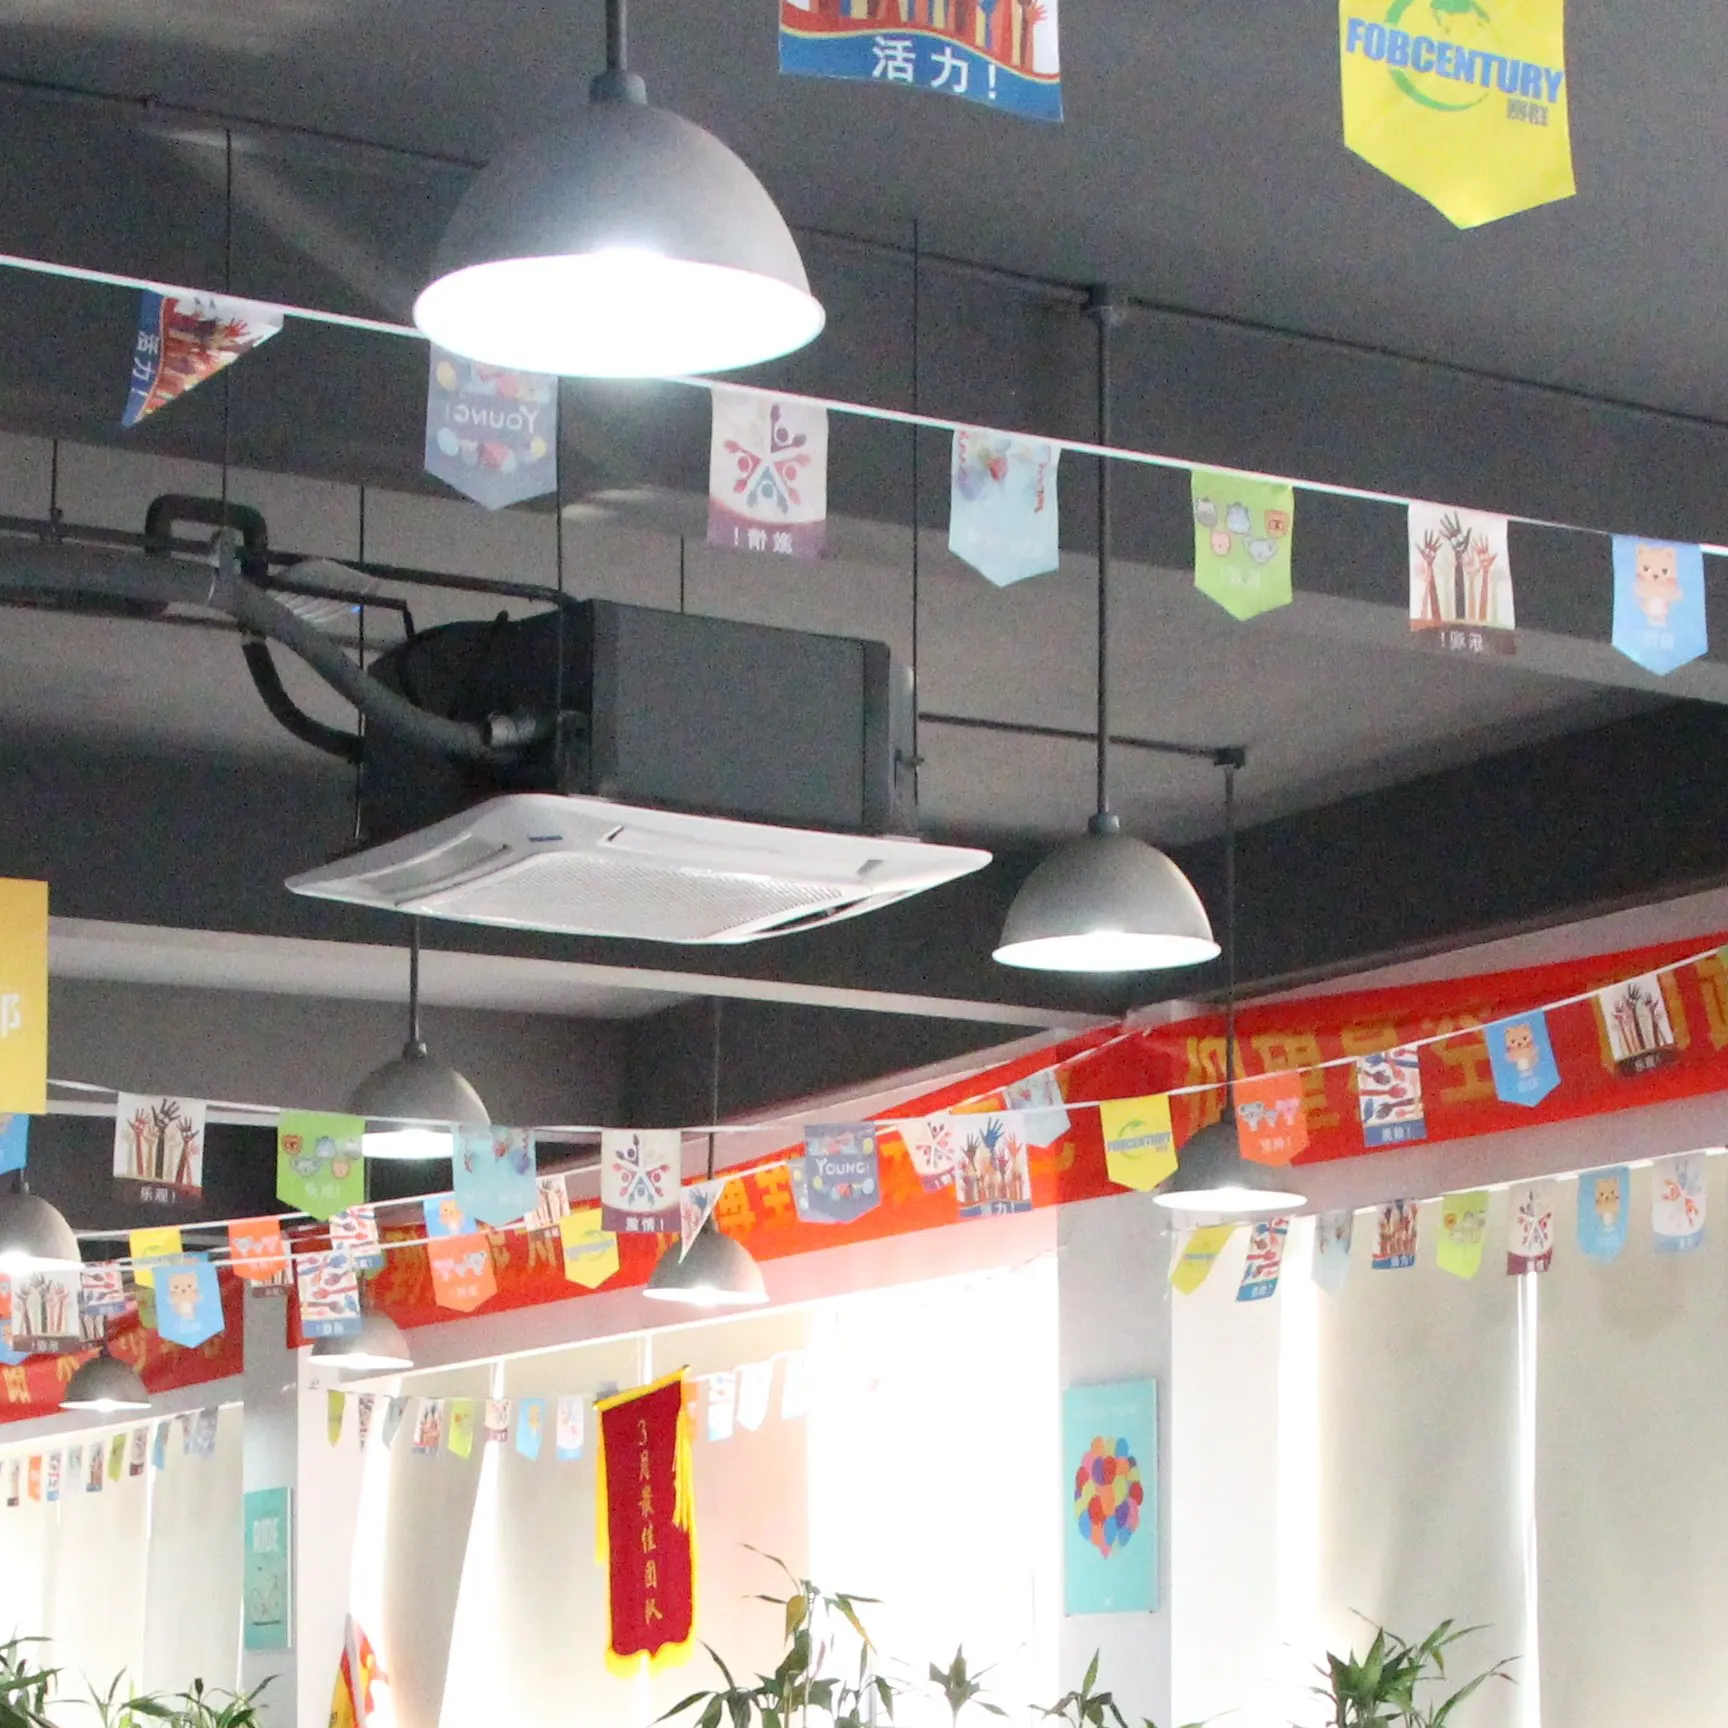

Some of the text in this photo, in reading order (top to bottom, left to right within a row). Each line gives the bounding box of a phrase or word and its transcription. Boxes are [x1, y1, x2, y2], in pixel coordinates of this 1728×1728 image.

[872, 35, 999, 101] 活力!
[1345, 17, 1565, 103] FOBCENTURY
[816, 1159, 870, 1176] YOUNG!
